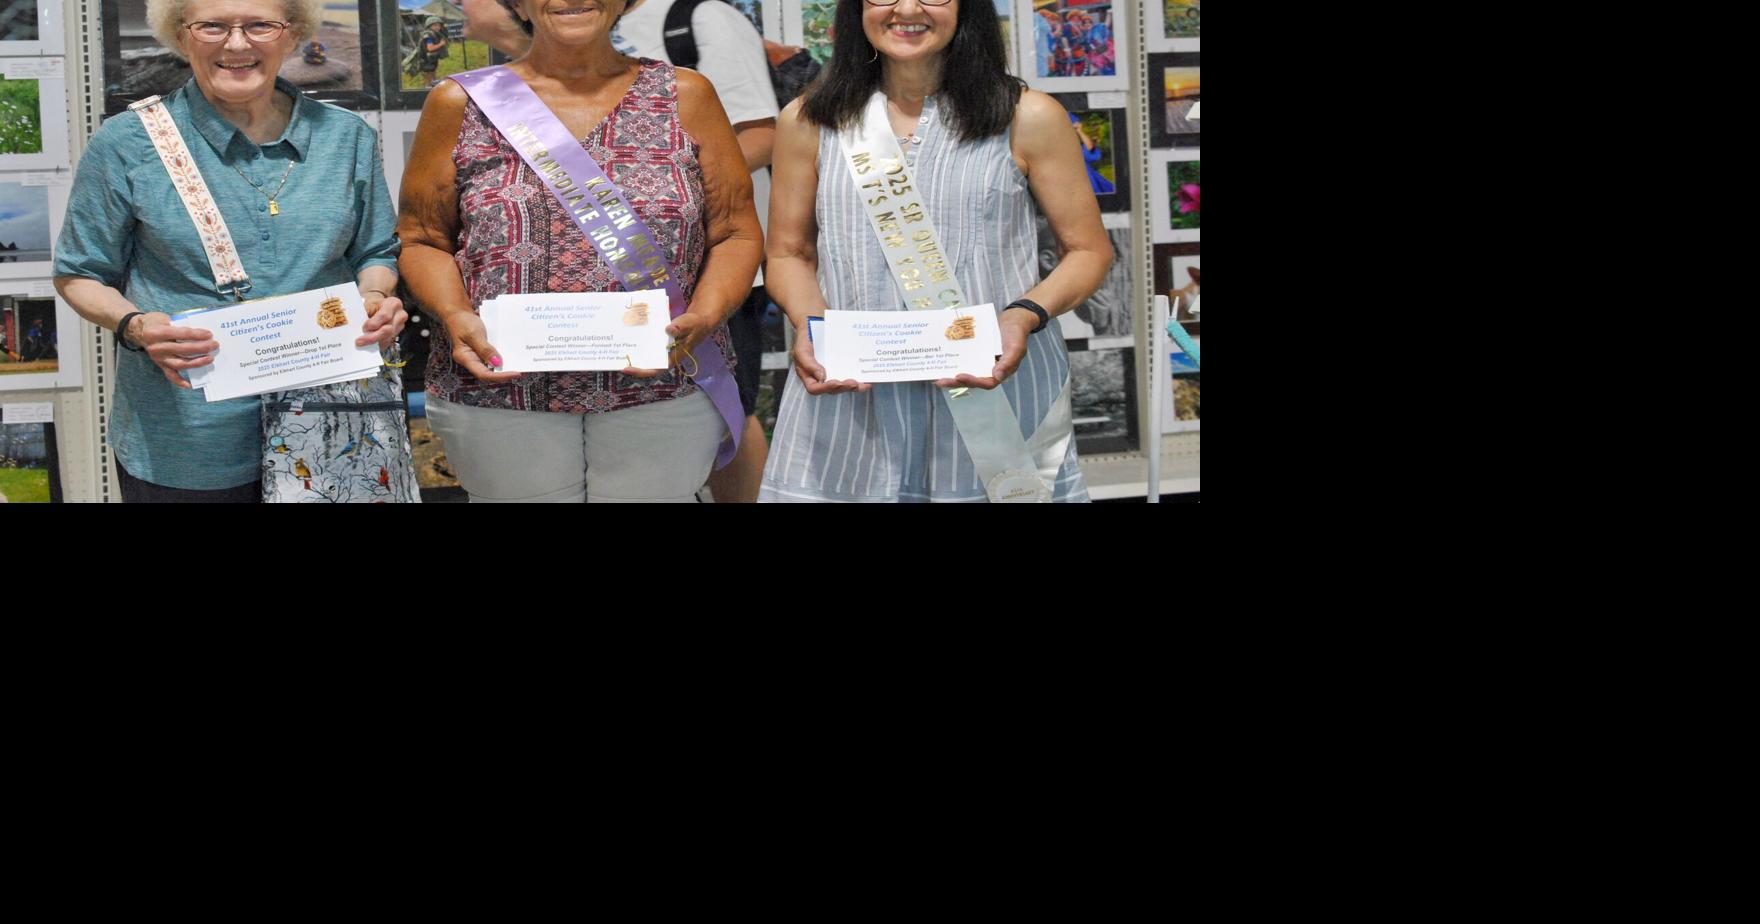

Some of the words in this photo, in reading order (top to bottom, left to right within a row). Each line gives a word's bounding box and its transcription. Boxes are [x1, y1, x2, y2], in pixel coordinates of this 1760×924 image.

[506, 121, 600, 224] INTERMEDIATE
[585, 176, 637, 230] KAREN
[851, 152, 872, 175] MS
[862, 179, 888, 207] T'S
[875, 211, 907, 248] NEW
[900, 202, 924, 225] SR
[912, 230, 950, 284] QUEEN
[221, 320, 238, 329] 41st
[240, 313, 269, 325] Annual
[271, 308, 296, 318] Senior
[230, 324, 264, 336] Citizen's
[266, 319, 294, 329] Cookie
[250, 332, 281, 343] Contest
[255, 337, 320, 356] Congratulations!
[291, 357, 310, 365] County
[876, 347, 941, 356] Congratulations!
